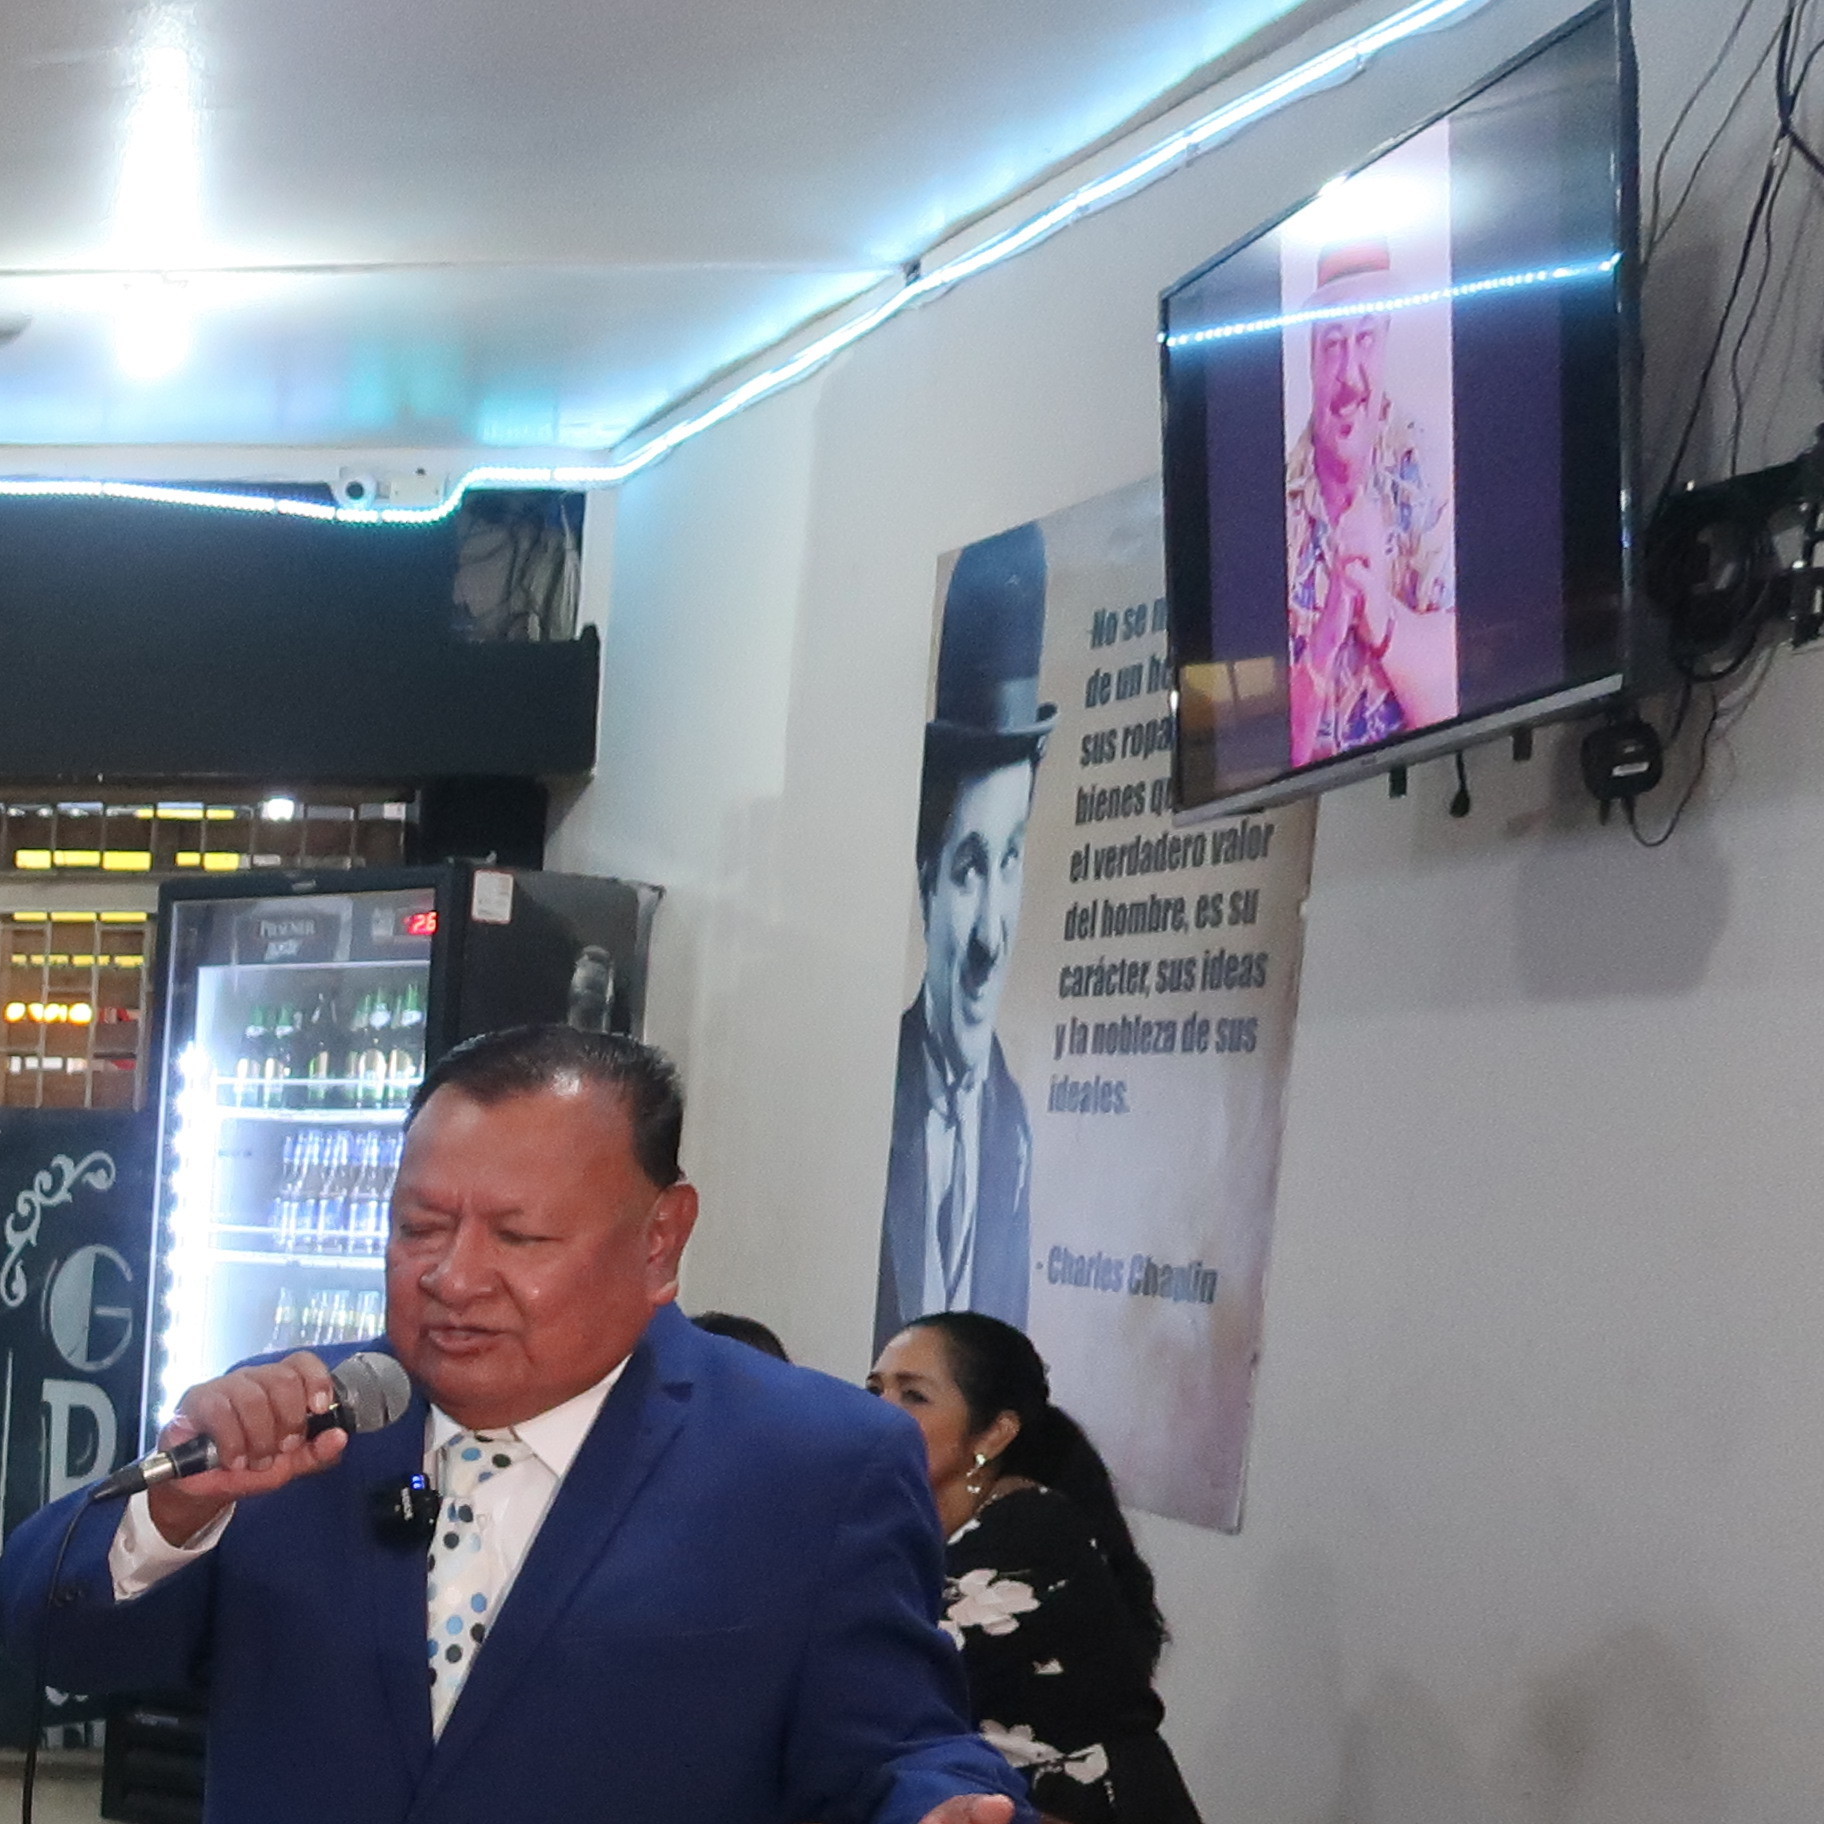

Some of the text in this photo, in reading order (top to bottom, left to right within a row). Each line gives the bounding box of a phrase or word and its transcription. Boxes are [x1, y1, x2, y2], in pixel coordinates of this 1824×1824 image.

[1090, 607, 1119, 650] No
[1122, 603, 1148, 642] se
[1085, 668, 1112, 709] de
[1115, 663, 1144, 701] un
[1079, 715, 1174, 768] sus ropa
[1074, 780, 1146, 826] bienes
[1069, 818, 1275, 884] el verdadero valor
[1063, 889, 1260, 942] del hombre, es su
[1058, 948, 1269, 999] carácter, sus ideas
[1053, 1011, 1259, 1061] y la nobleza de sus
[1047, 1246, 1125, 1293] Charles
[1128, 1252, 1218, 1305] Chaplin
